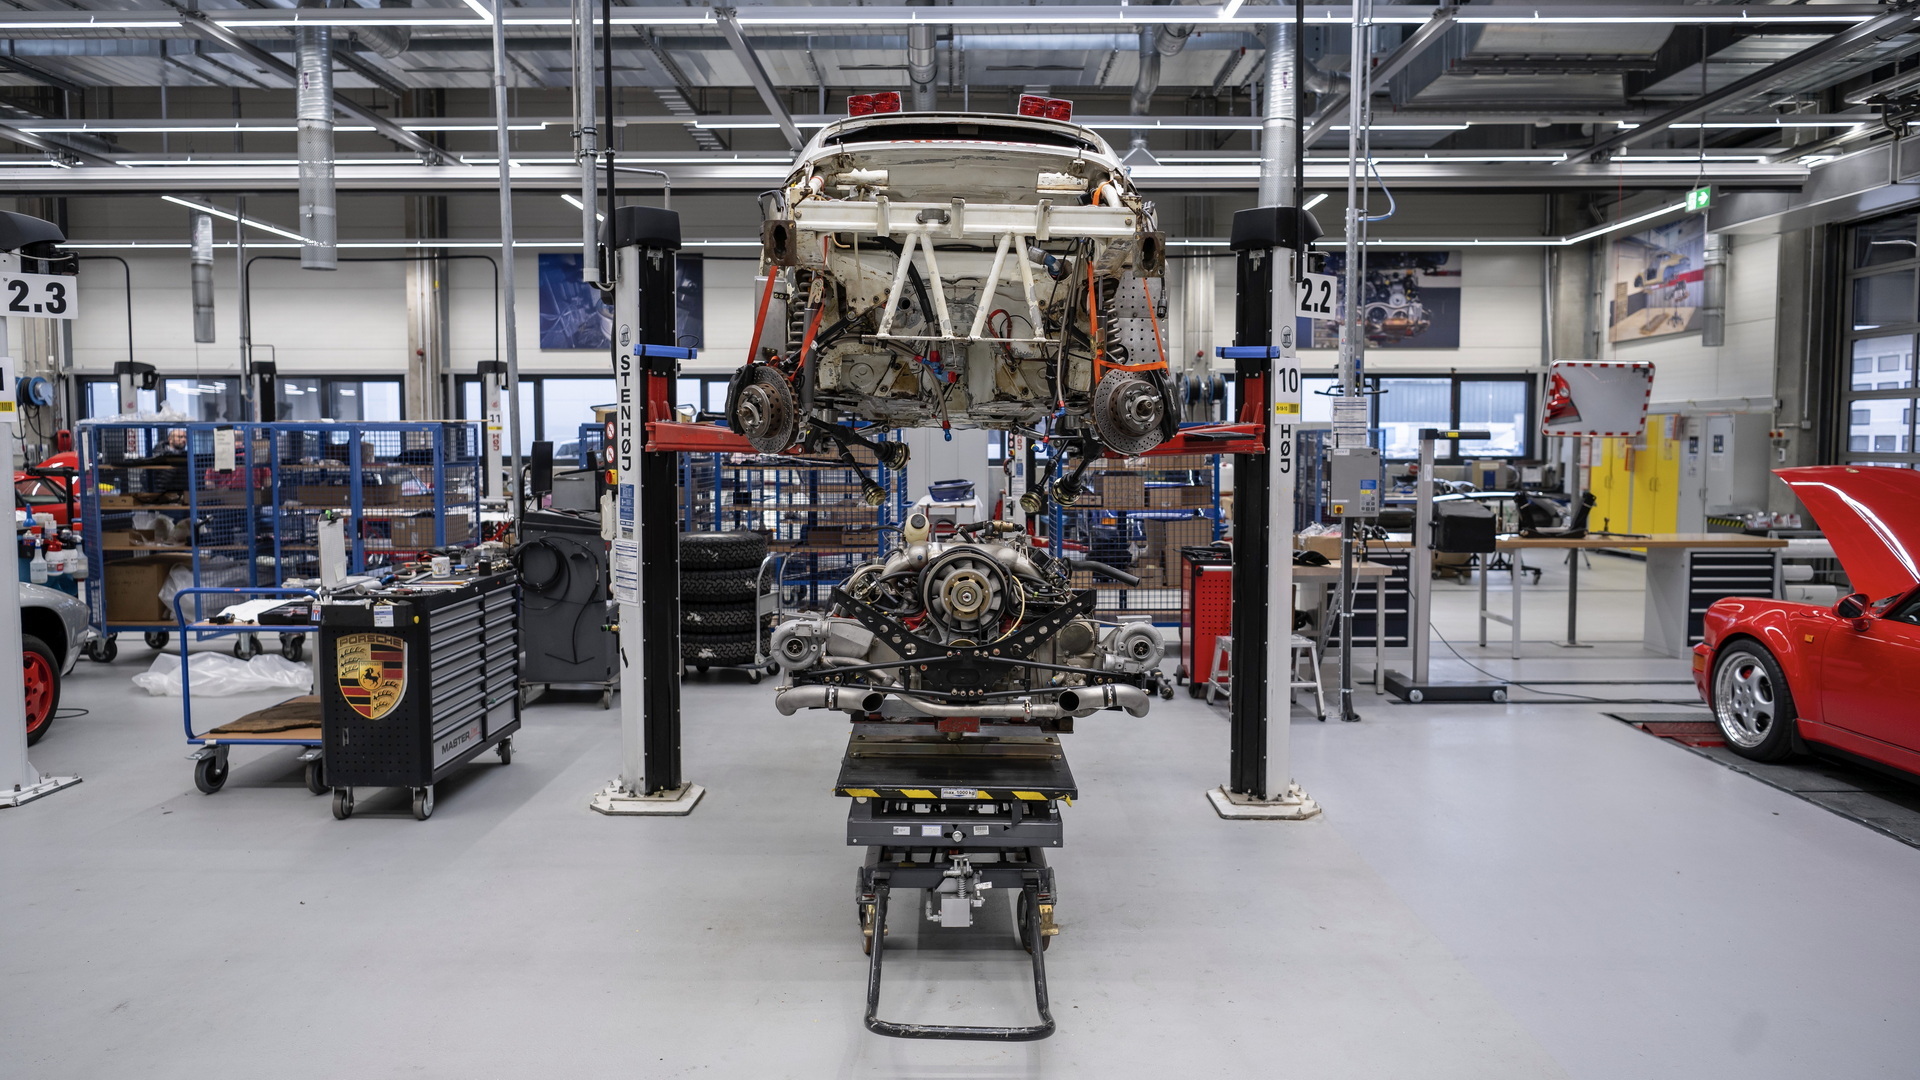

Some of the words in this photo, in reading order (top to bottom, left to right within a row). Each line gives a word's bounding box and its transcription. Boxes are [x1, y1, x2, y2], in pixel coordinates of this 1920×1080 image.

[8, 280, 67, 314] 2.3
[1301, 278, 1331, 314] 2.2
[1279, 368, 1298, 393] 10
[490, 414, 500, 423] 11
[620, 355, 631, 471] STENHØJ
[340, 634, 402, 648] PORSCHE
